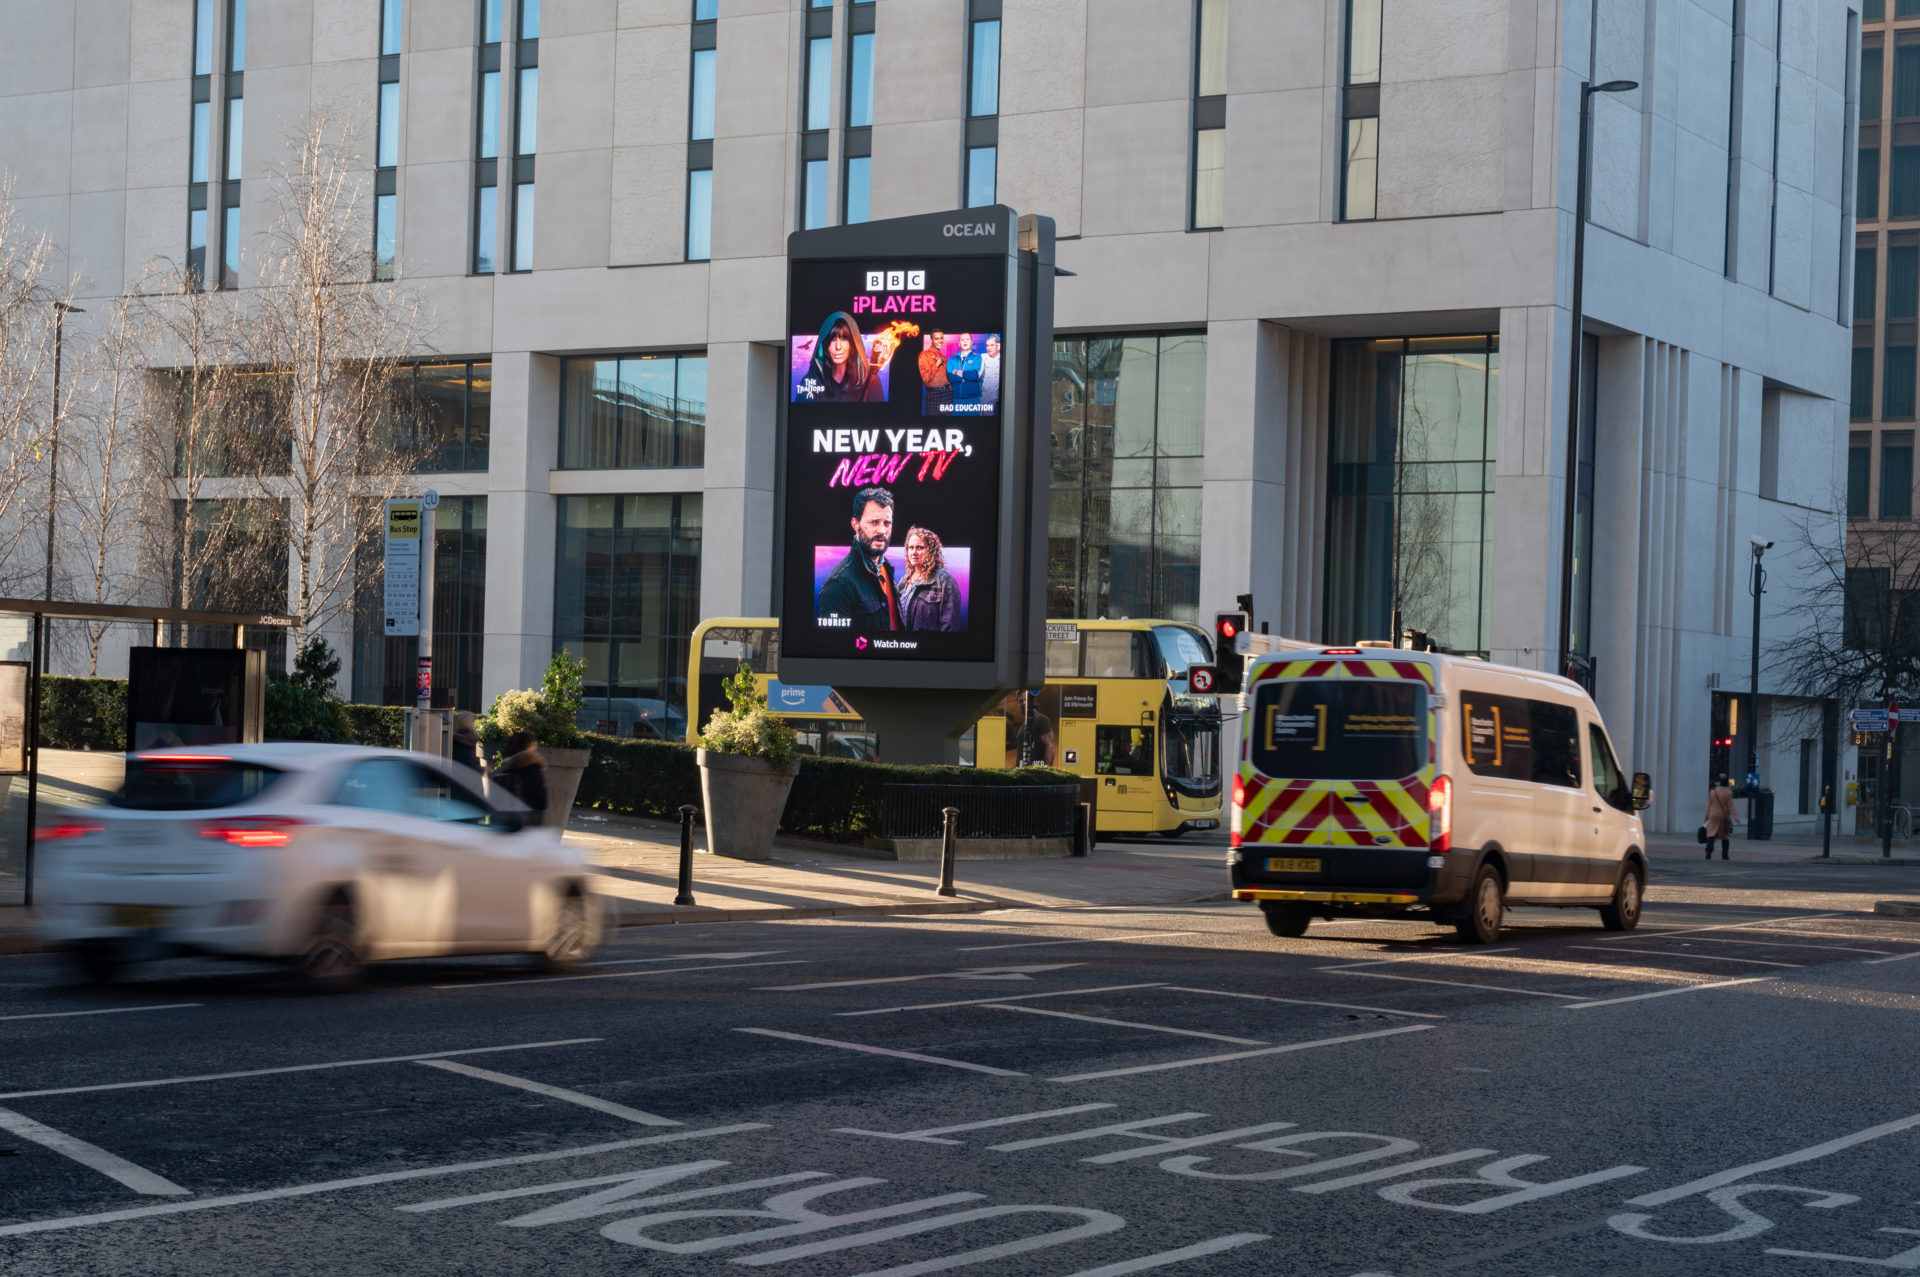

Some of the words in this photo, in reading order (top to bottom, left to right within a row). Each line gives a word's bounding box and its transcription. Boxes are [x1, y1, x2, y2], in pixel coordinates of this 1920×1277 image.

[943, 223, 996, 237] OCEAN
[868, 272, 923, 289] BBC
[853, 295, 936, 314] iPLAYER
[805, 378, 817, 386] THE
[940, 403, 954, 412] BAD
[955, 403, 994, 412] EDUCATION
[813, 429, 879, 452] NEW
[885, 429, 973, 456] YEAR,
[829, 453, 912, 488] NEW
[917, 448, 960, 482] TV
[425, 494, 438, 505] CU
[403, 525, 418, 534] Stop
[259, 615, 293, 626] JCDecaux
[817, 618, 852, 627] TOURIST
[873, 640, 899, 649] Watch
[900, 641, 918, 649] now
[781, 687, 806, 698] prime
[831, 1102, 1648, 1214] RIGHT
